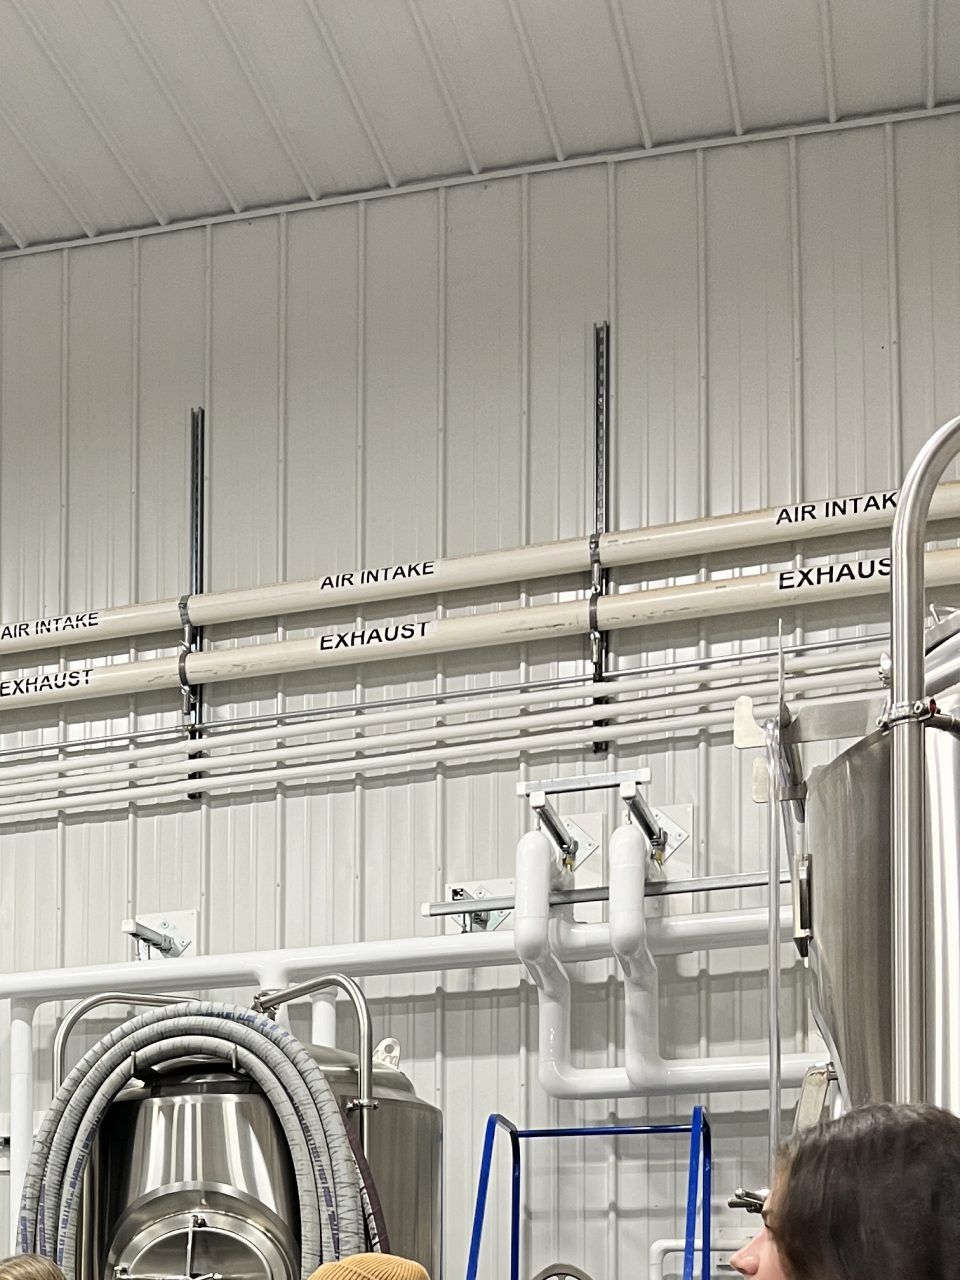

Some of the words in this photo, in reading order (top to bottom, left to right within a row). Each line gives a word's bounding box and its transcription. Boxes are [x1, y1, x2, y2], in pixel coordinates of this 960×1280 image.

[775, 504, 817, 525] AIR
[825, 492, 898, 518] INTAK
[320, 573, 354, 590] AIR
[360, 561, 435, 584] INTAKE
[778, 558, 891, 590] EXHAUS
[0, 623, 30, 640] AIR
[35, 612, 99, 635] INTAKE
[320, 621, 431, 651] EXHAUST
